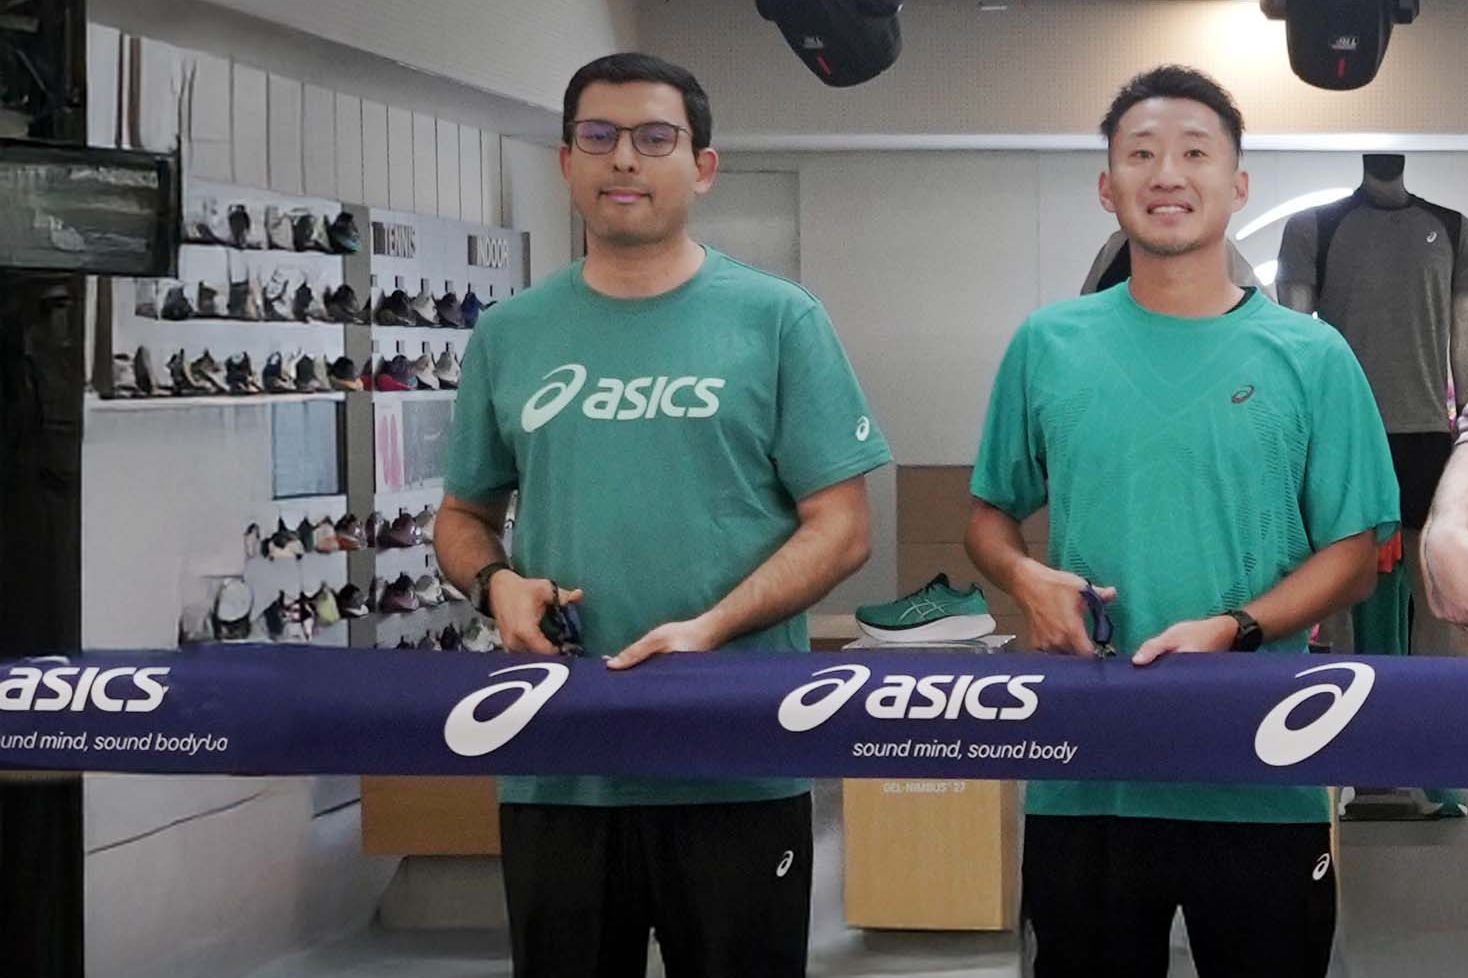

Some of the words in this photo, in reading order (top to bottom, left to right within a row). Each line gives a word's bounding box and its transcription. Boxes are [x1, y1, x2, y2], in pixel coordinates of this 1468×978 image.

[384, 224, 416, 258] TENNIS
[476, 236, 511, 270] INDOOR
[0, 731, 38, 749] und
[40, 731, 88, 751] mind,
[93, 733, 152, 751] sound
[853, 739, 911, 757] sound
[913, 739, 962, 760] mind,
[968, 741, 1026, 759] sound
[1029, 742, 1077, 764] body
